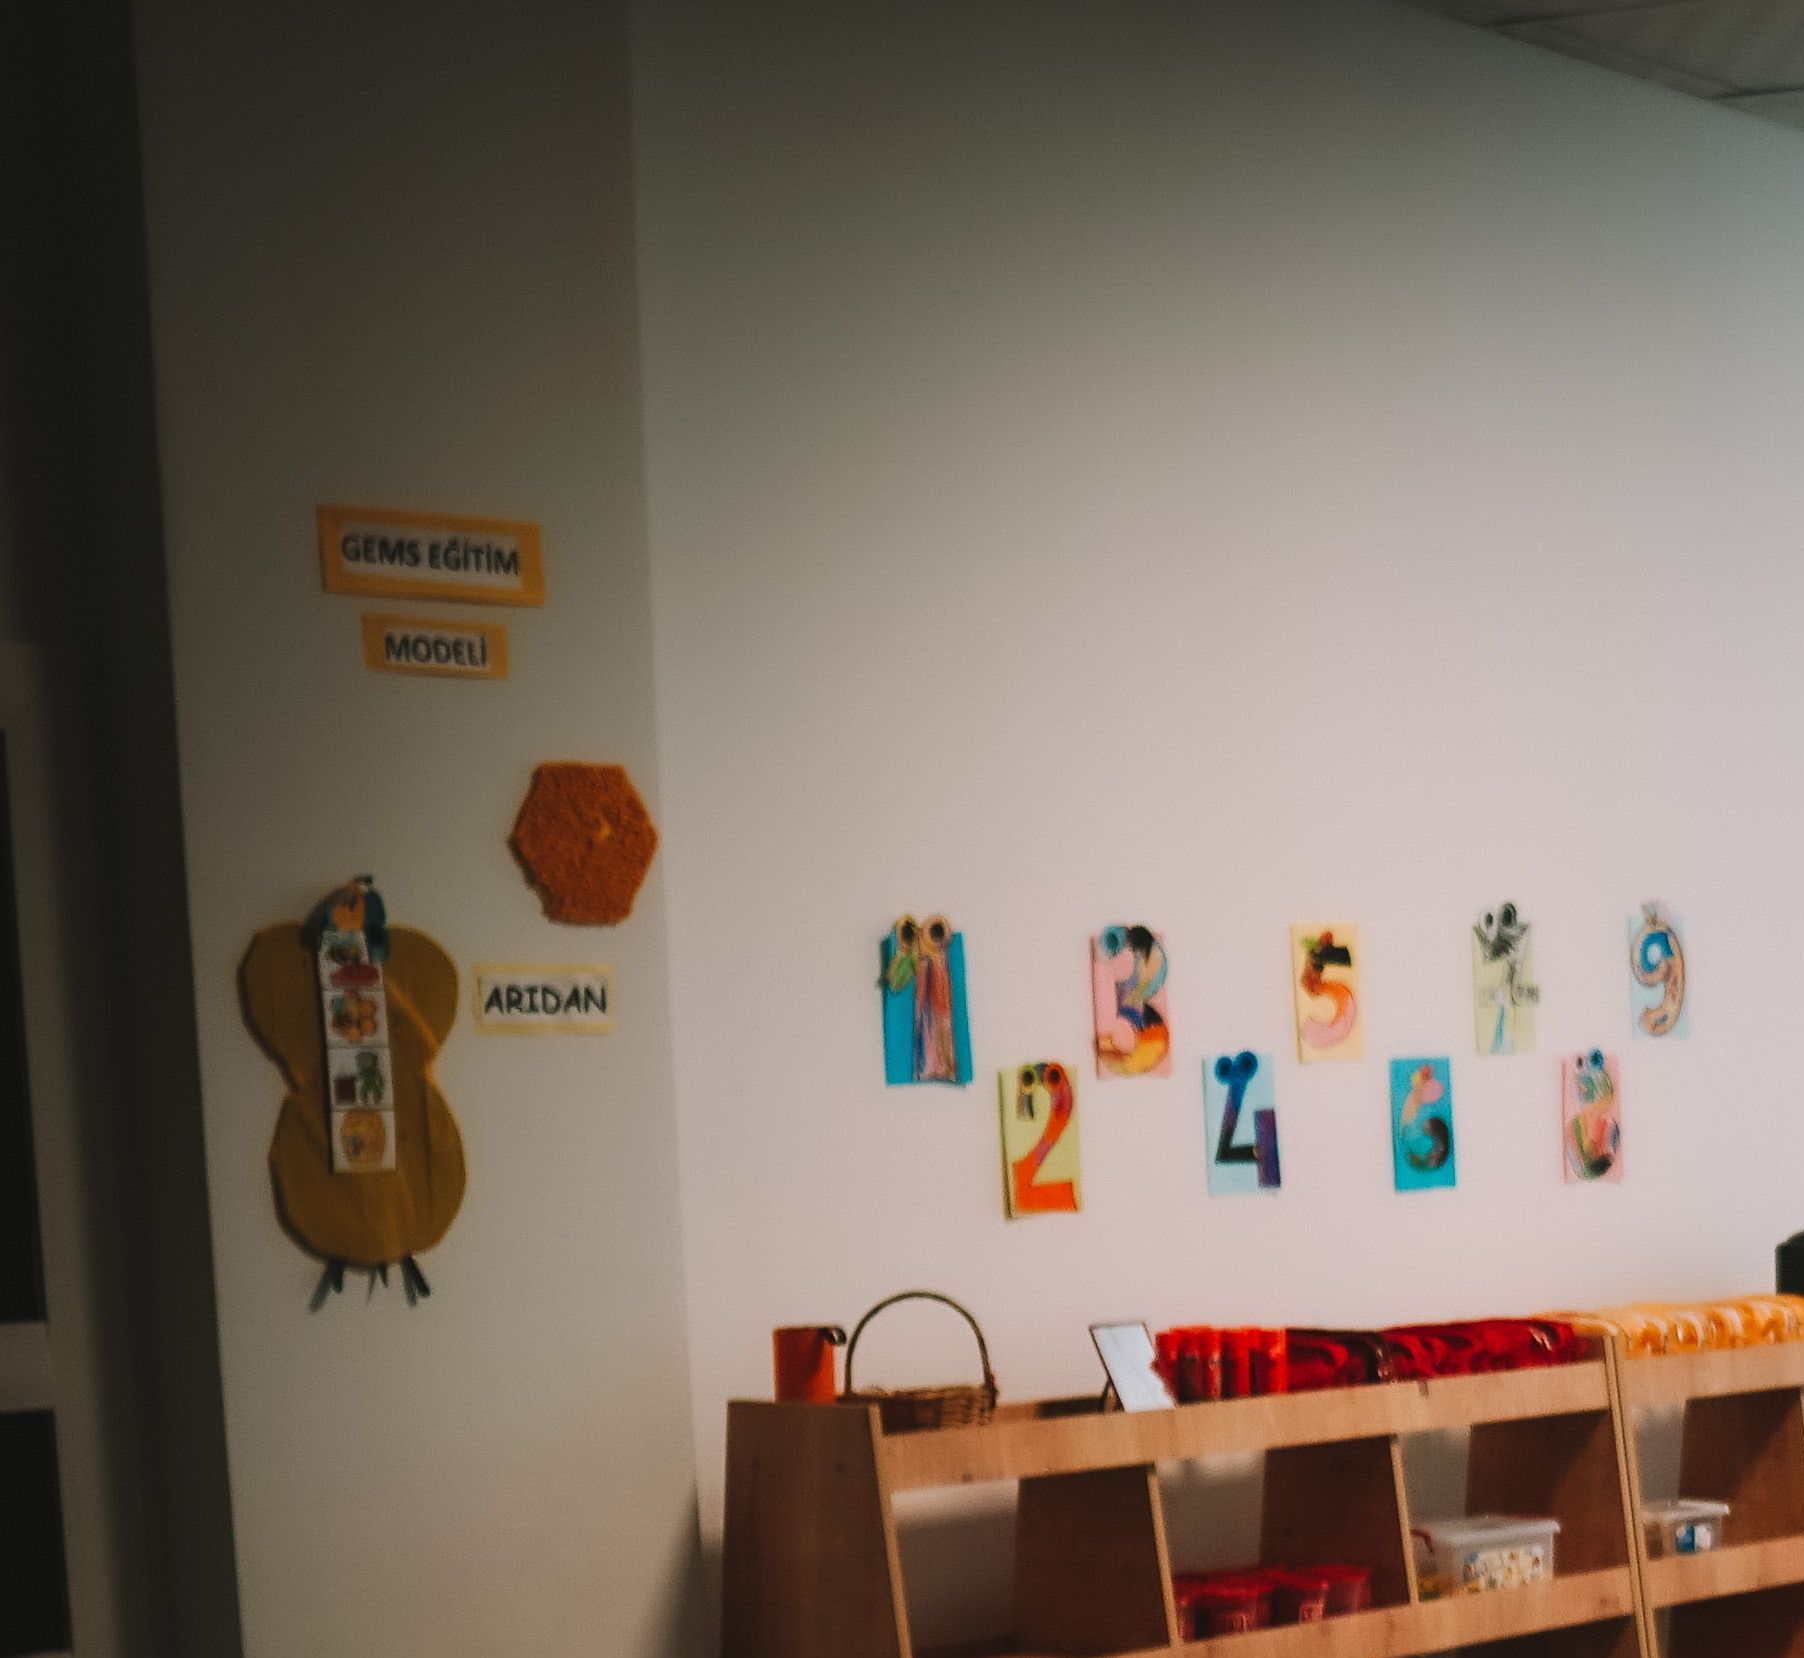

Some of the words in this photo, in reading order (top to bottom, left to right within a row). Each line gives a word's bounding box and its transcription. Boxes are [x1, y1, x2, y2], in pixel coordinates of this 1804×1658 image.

[341, 532, 421, 567] GEMS
[427, 536, 520, 576] EĞİTİM
[384, 631, 489, 667] MODELİ
[484, 983, 607, 1015] ARIDAN
[1097, 925, 1170, 1076] 3
[1301, 928, 1357, 1049] 5
[1631, 914, 1686, 1037] 9
[1013, 1061, 1078, 1212] 2
[1213, 1050, 1281, 1188] 4
[1401, 1063, 1450, 1173] 6
